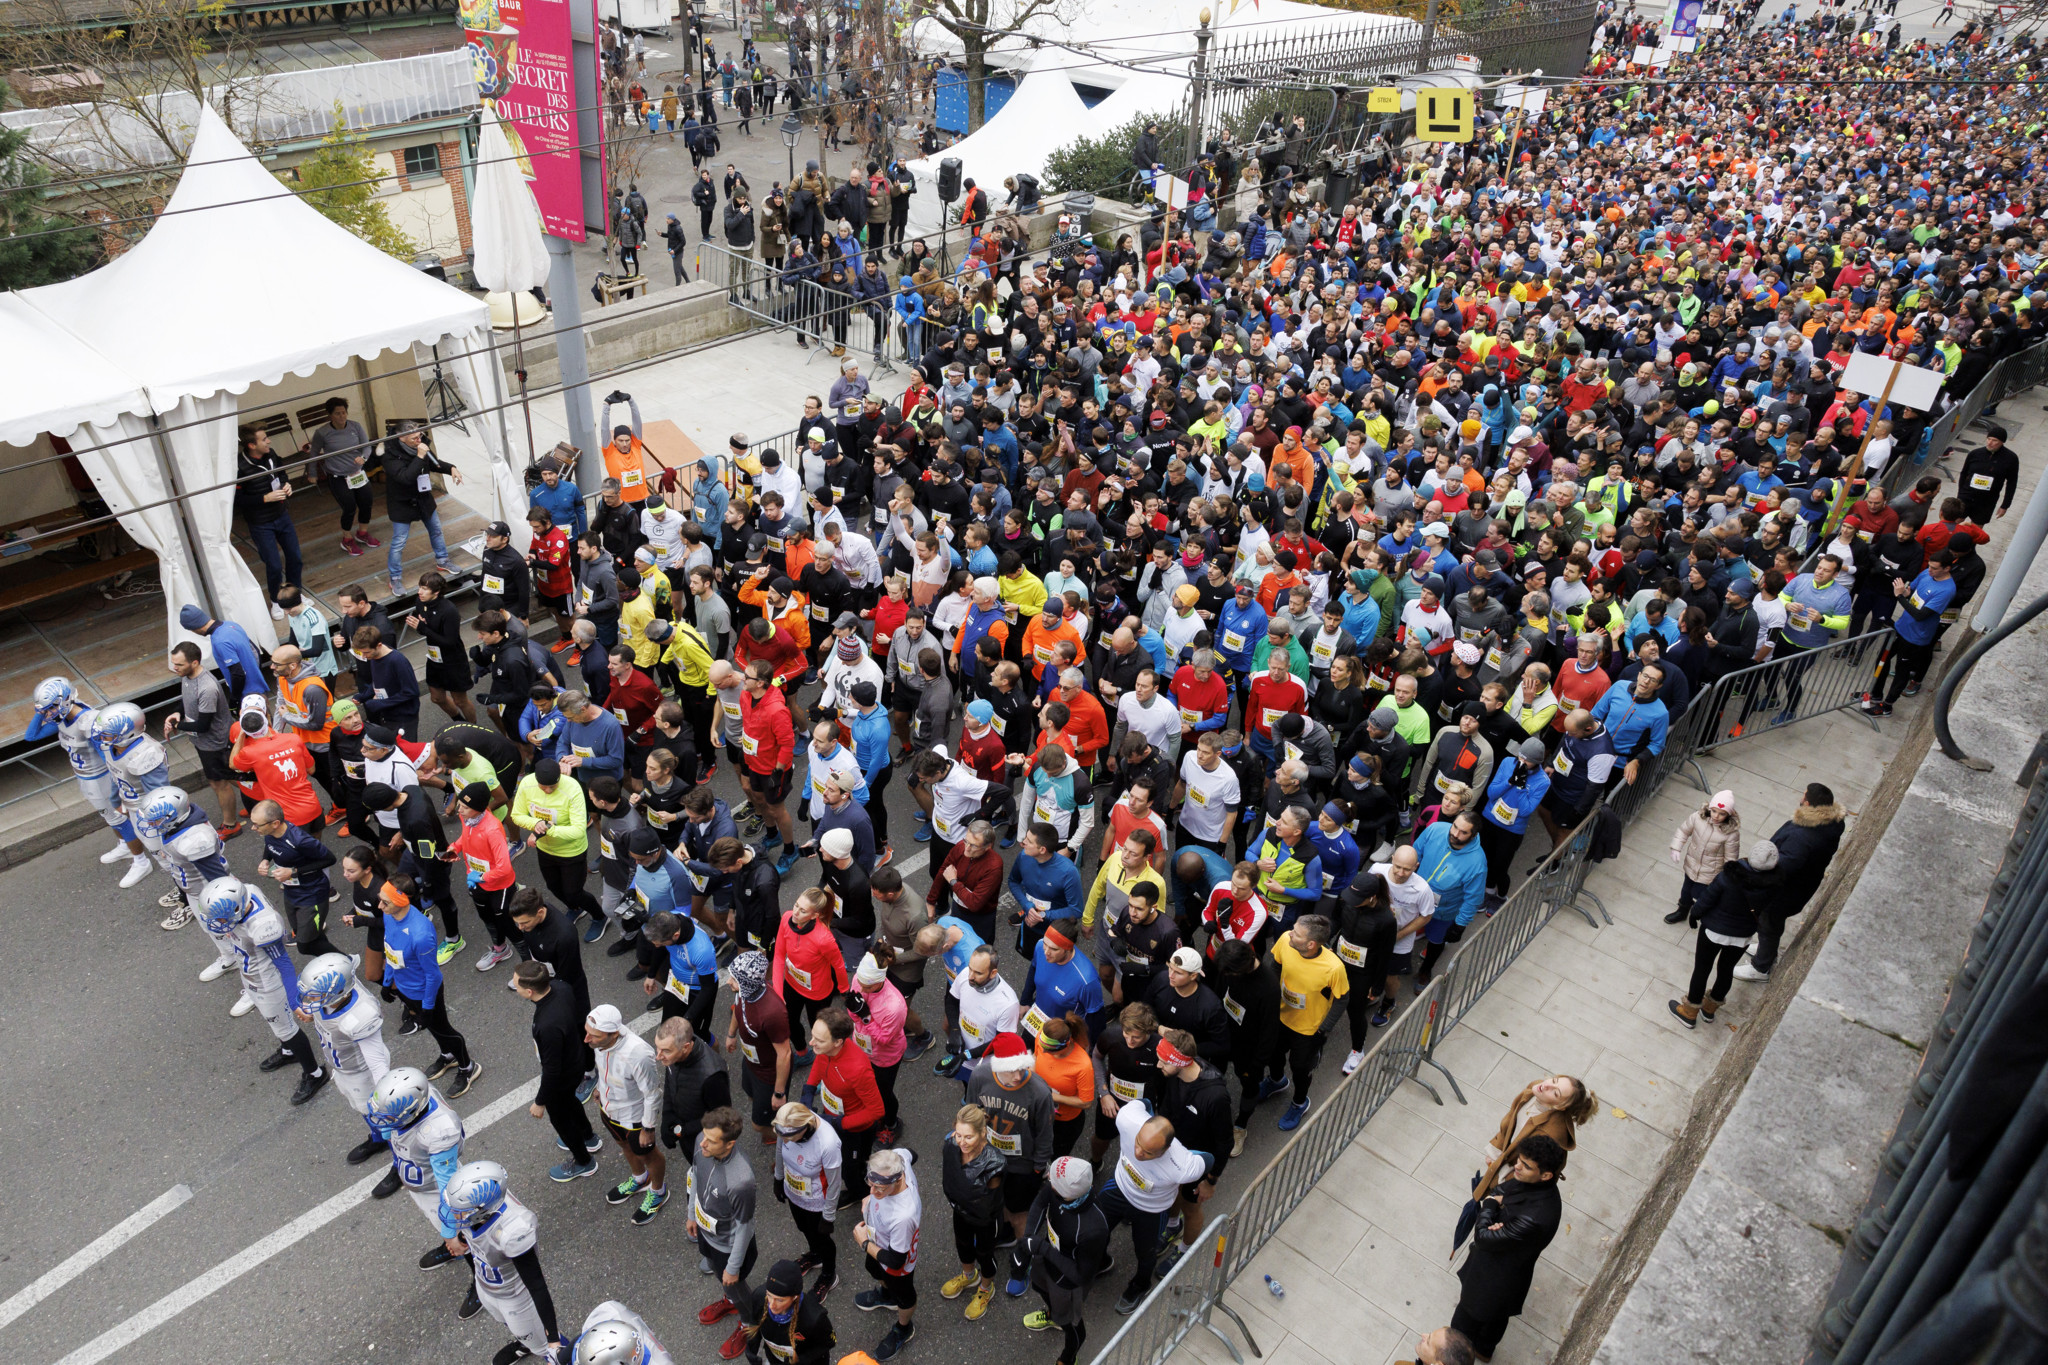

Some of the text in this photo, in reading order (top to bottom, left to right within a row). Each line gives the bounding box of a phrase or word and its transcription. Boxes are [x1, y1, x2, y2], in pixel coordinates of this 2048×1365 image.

[498, 0, 521, 14] BAUR
[518, 47, 533, 64] LE
[507, 62, 568, 92] SECRET
[546, 92, 568, 109] DES
[484, 97, 569, 132] OULEURS
[268, 748, 295, 760] CAMEL
[991, 1131, 1013, 1141] MIGROS
